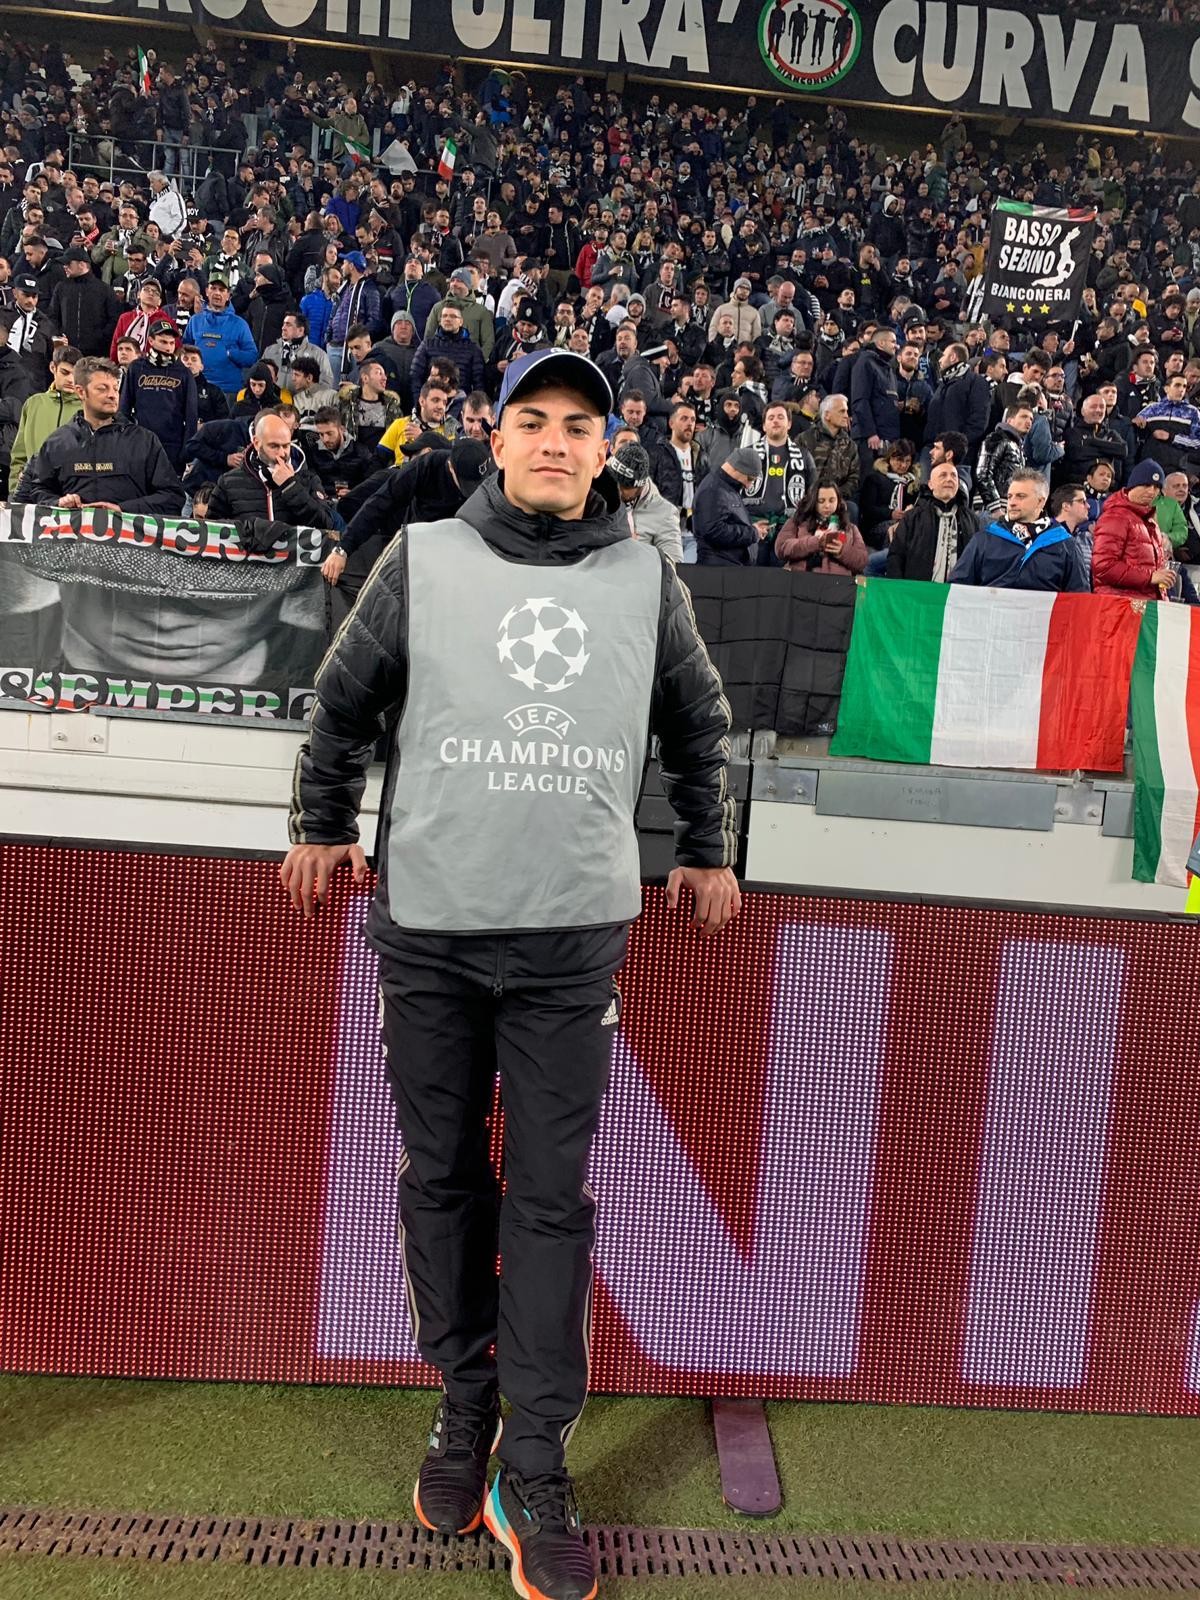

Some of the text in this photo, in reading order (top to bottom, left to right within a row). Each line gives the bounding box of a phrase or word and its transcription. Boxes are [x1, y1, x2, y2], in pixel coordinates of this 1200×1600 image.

[873, 4, 1150, 123] CURVA
[1004, 217, 1062, 246] BASSO
[999, 245, 1056, 275] SEBINO
[991, 283, 1071, 301] BIANCONERA
[33, 671, 282, 718] SEMPER
[508, 709, 571, 737] UEFA
[439, 737, 625, 773] CHAMPIONS
[488, 772, 588, 795] LEAGUE
[315, 893, 1200, 1394] NI
